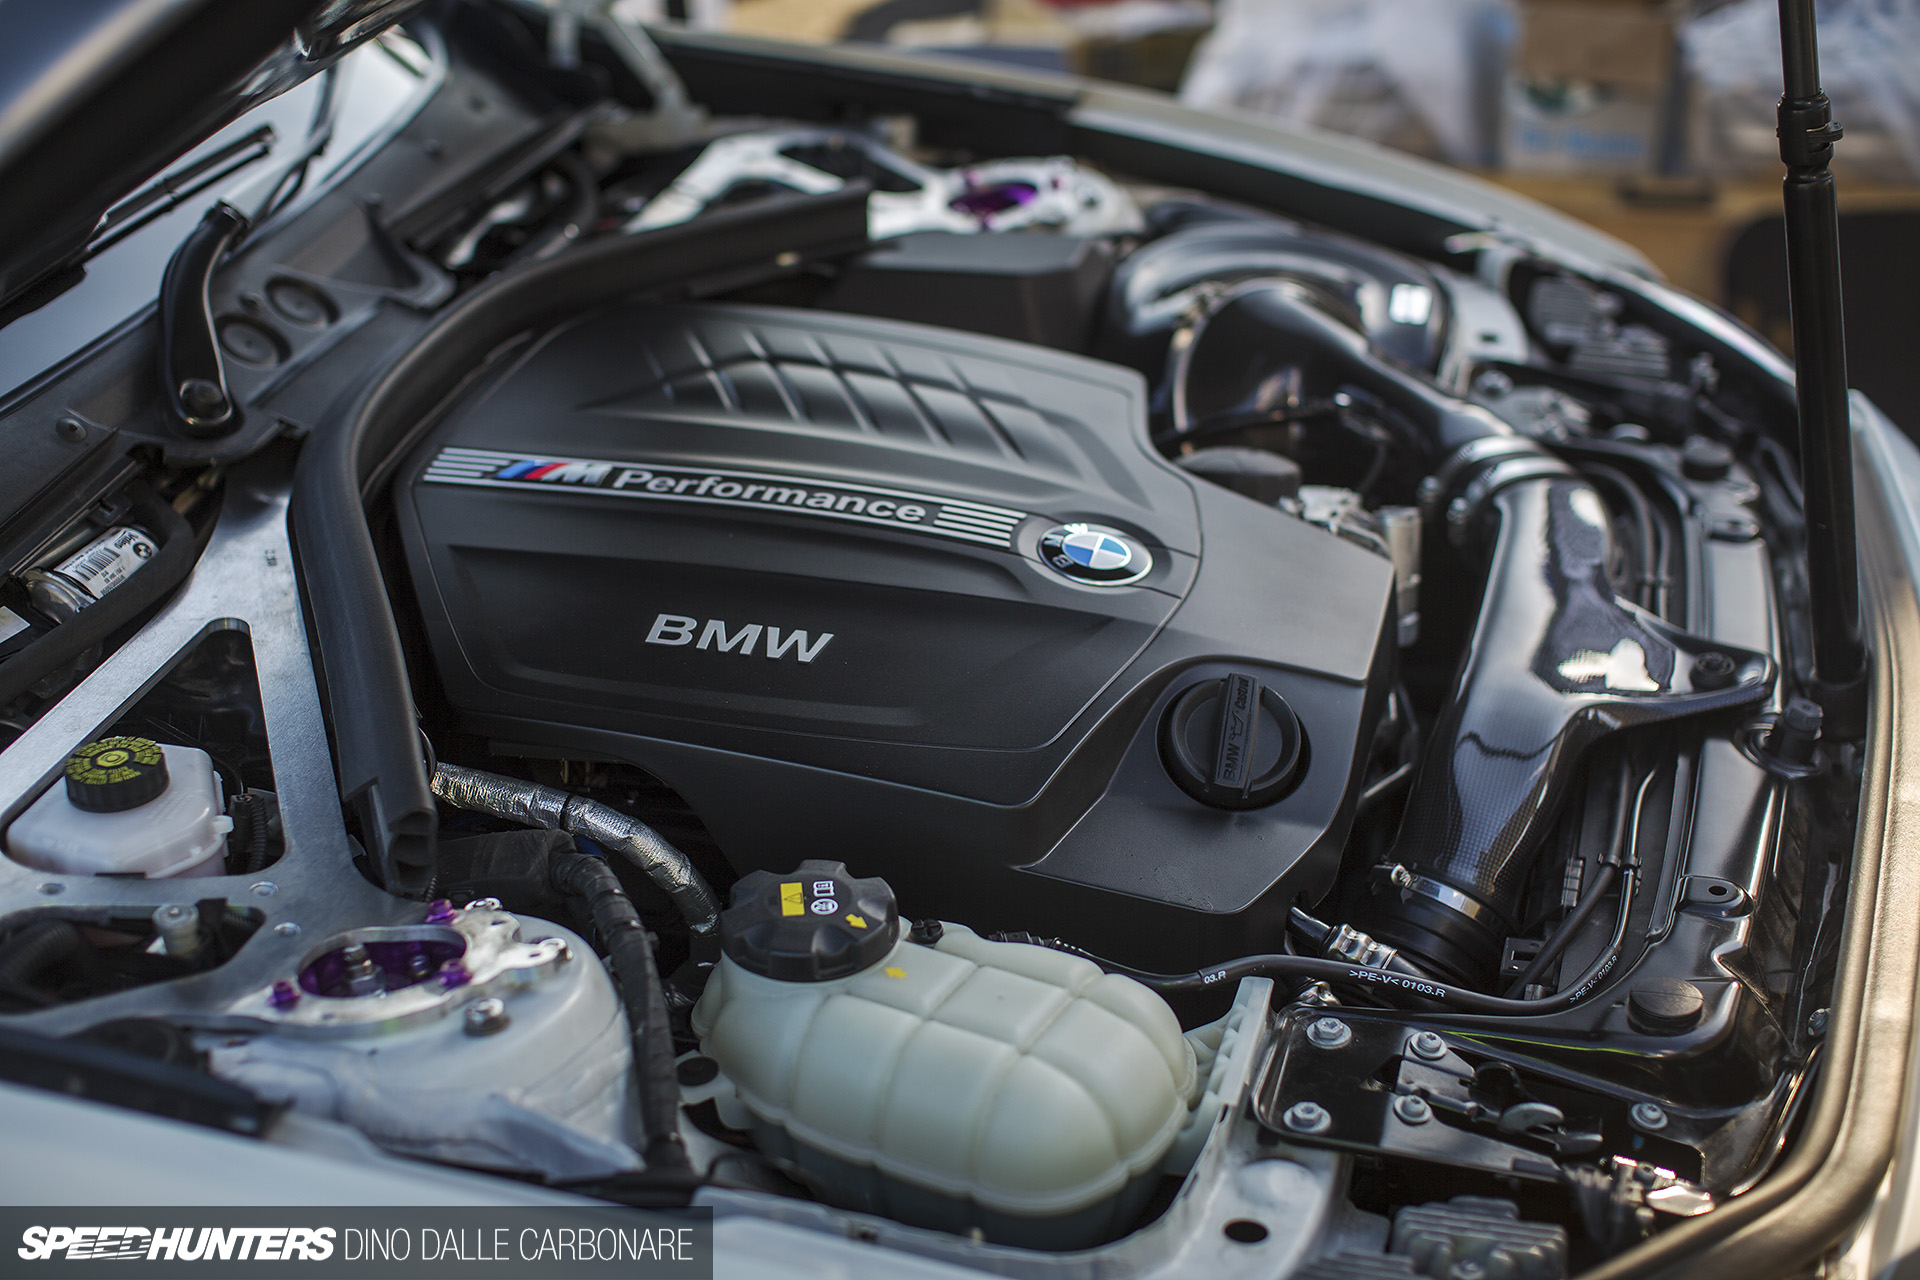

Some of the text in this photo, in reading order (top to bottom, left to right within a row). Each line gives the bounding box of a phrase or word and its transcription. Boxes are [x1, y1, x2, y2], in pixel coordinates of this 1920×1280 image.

[613, 469, 927, 522] Performance
[645, 613, 835, 663] BMW
[1223, 743, 1240, 779] BMW
[1234, 676, 1250, 710] Castrol
[1349, 969, 1447, 998] >PE-V< 0103.R
